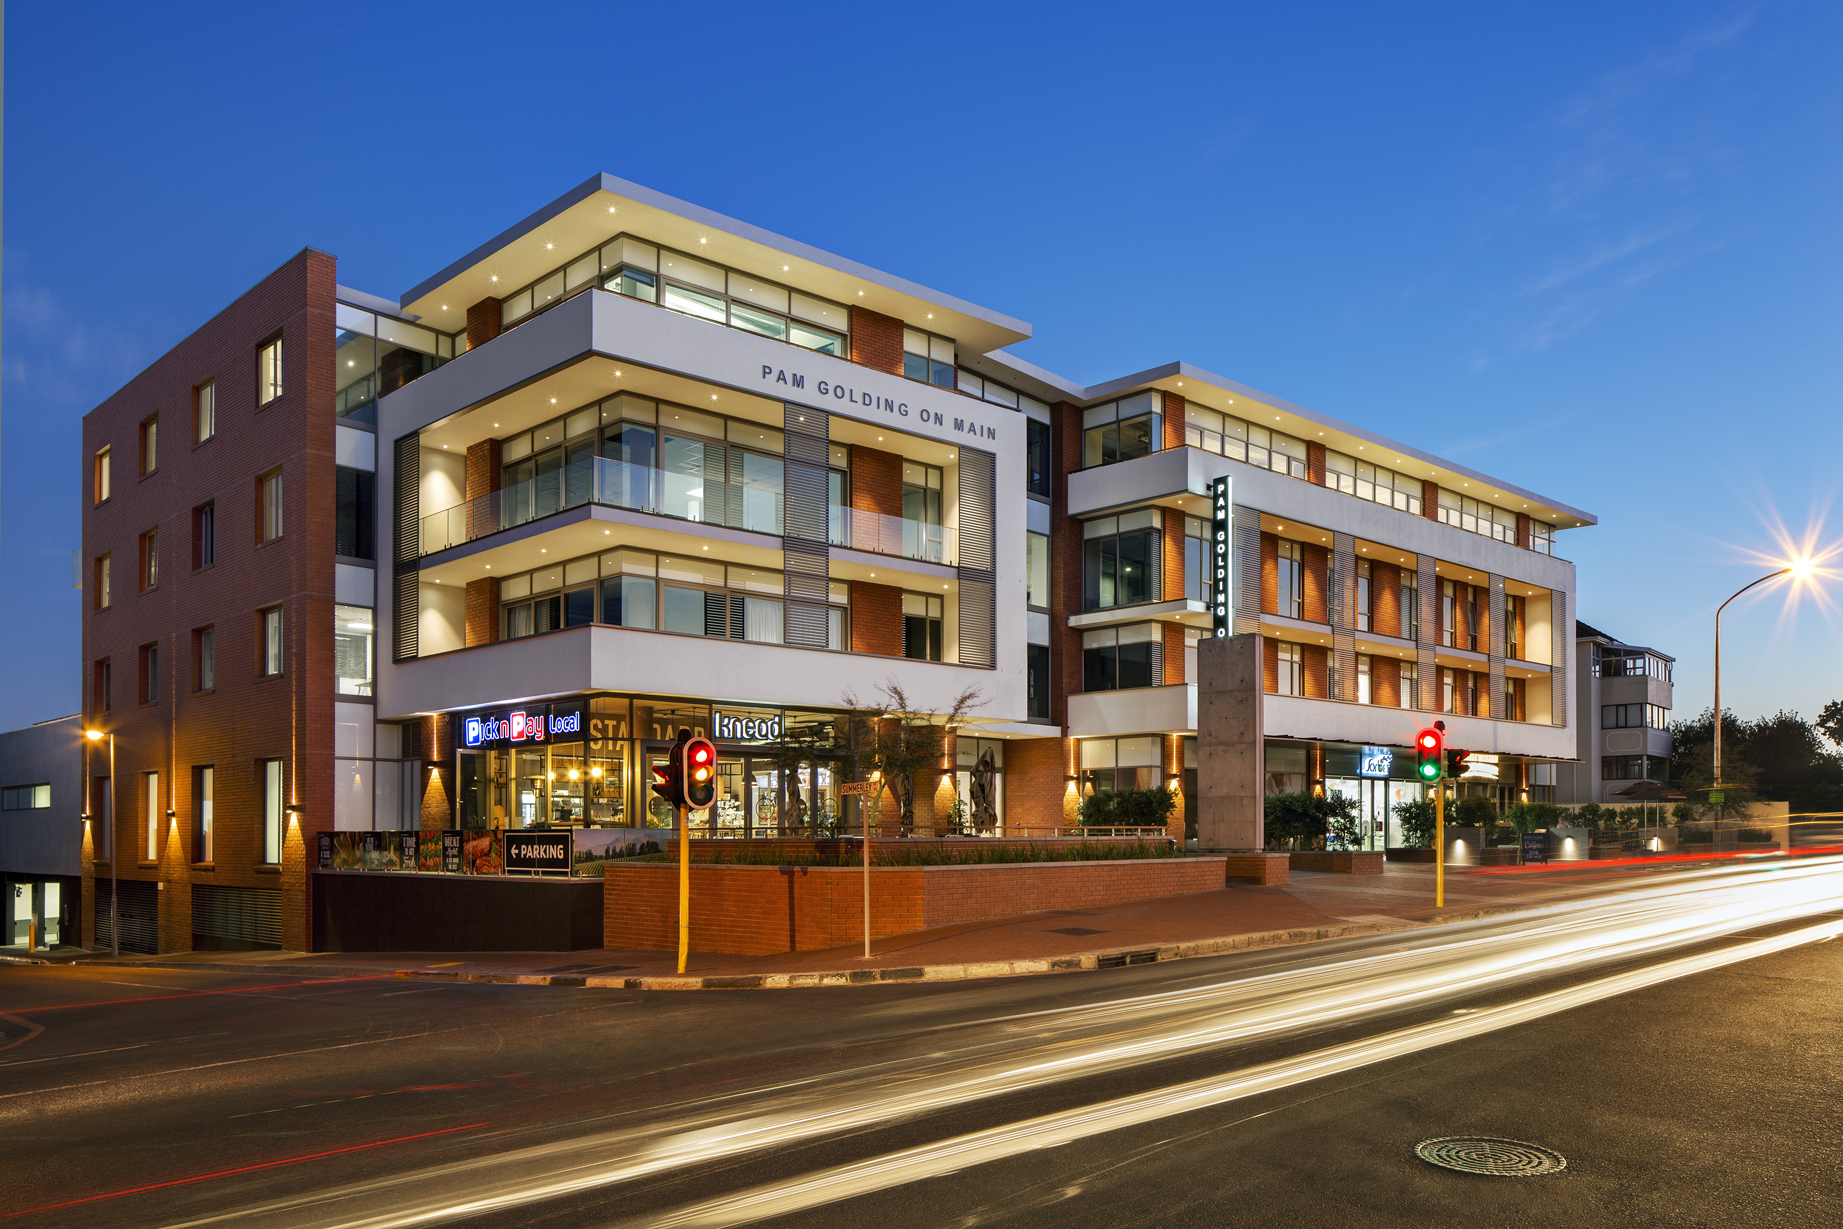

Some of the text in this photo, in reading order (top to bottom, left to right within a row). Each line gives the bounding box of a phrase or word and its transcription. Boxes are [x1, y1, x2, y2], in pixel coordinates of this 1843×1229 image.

[762, 364, 997, 441] PAM GOLDING ON MAIN
[1217, 484, 1225, 519] PAM
[1217, 531, 1226, 616] GOLDING
[549, 711, 580, 734] Local
[714, 711, 780, 741] knead
[842, 783, 872, 793] SUMMERLEY
[444, 836, 460, 848] MEAT
[521, 844, 564, 859] PARKING
